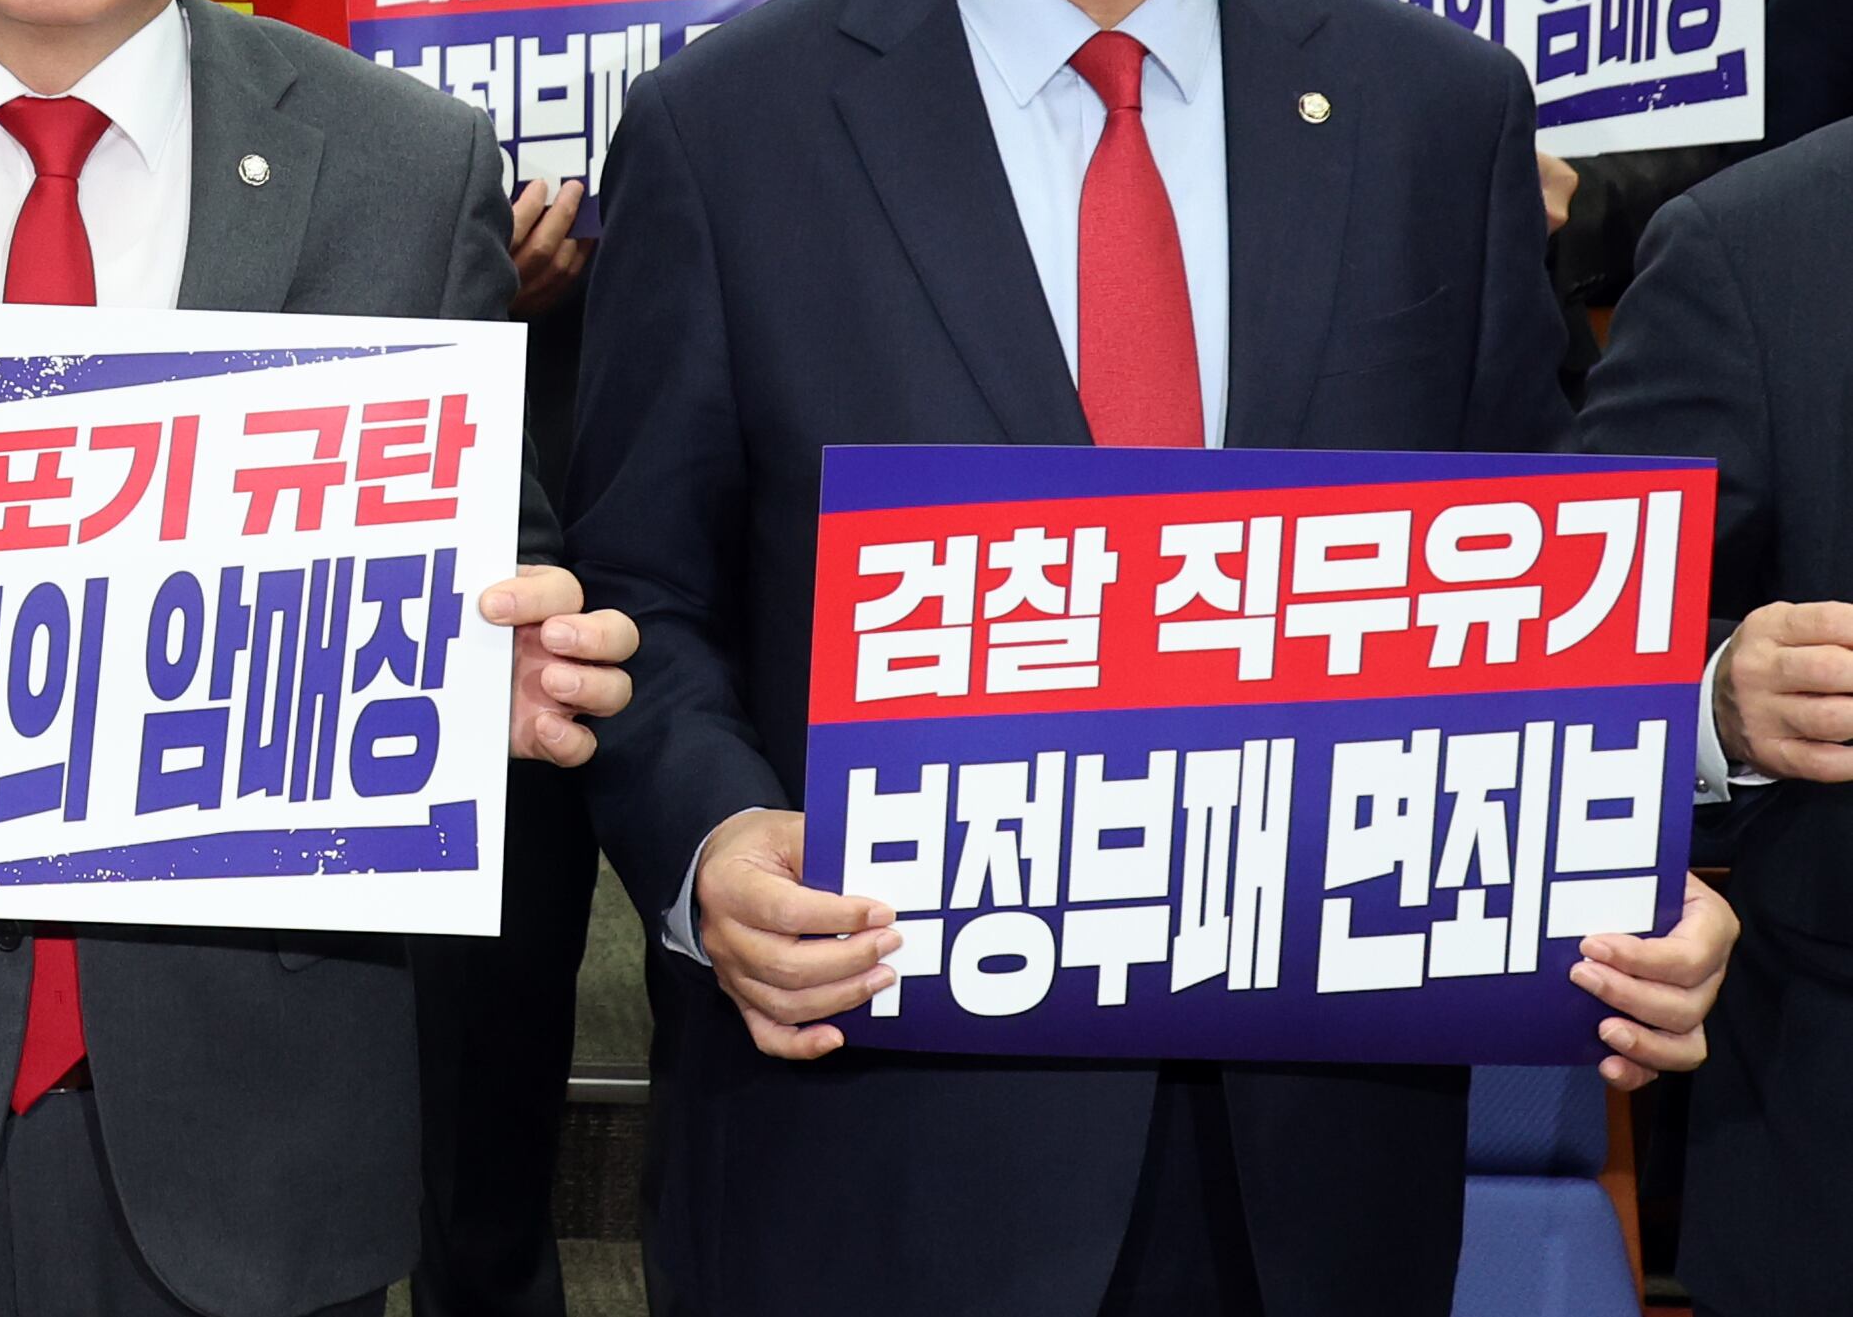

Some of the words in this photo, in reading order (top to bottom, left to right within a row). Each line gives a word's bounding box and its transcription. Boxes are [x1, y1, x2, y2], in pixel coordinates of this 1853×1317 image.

[233, 392, 478, 537] 규탄
[134, 546, 465, 817] 암매장
[853, 524, 1119, 705] 검찰
[1153, 489, 1683, 683] 직무유기
[842, 737, 1297, 1018] 부정부패
[1316, 718, 1668, 995] 면죄부
